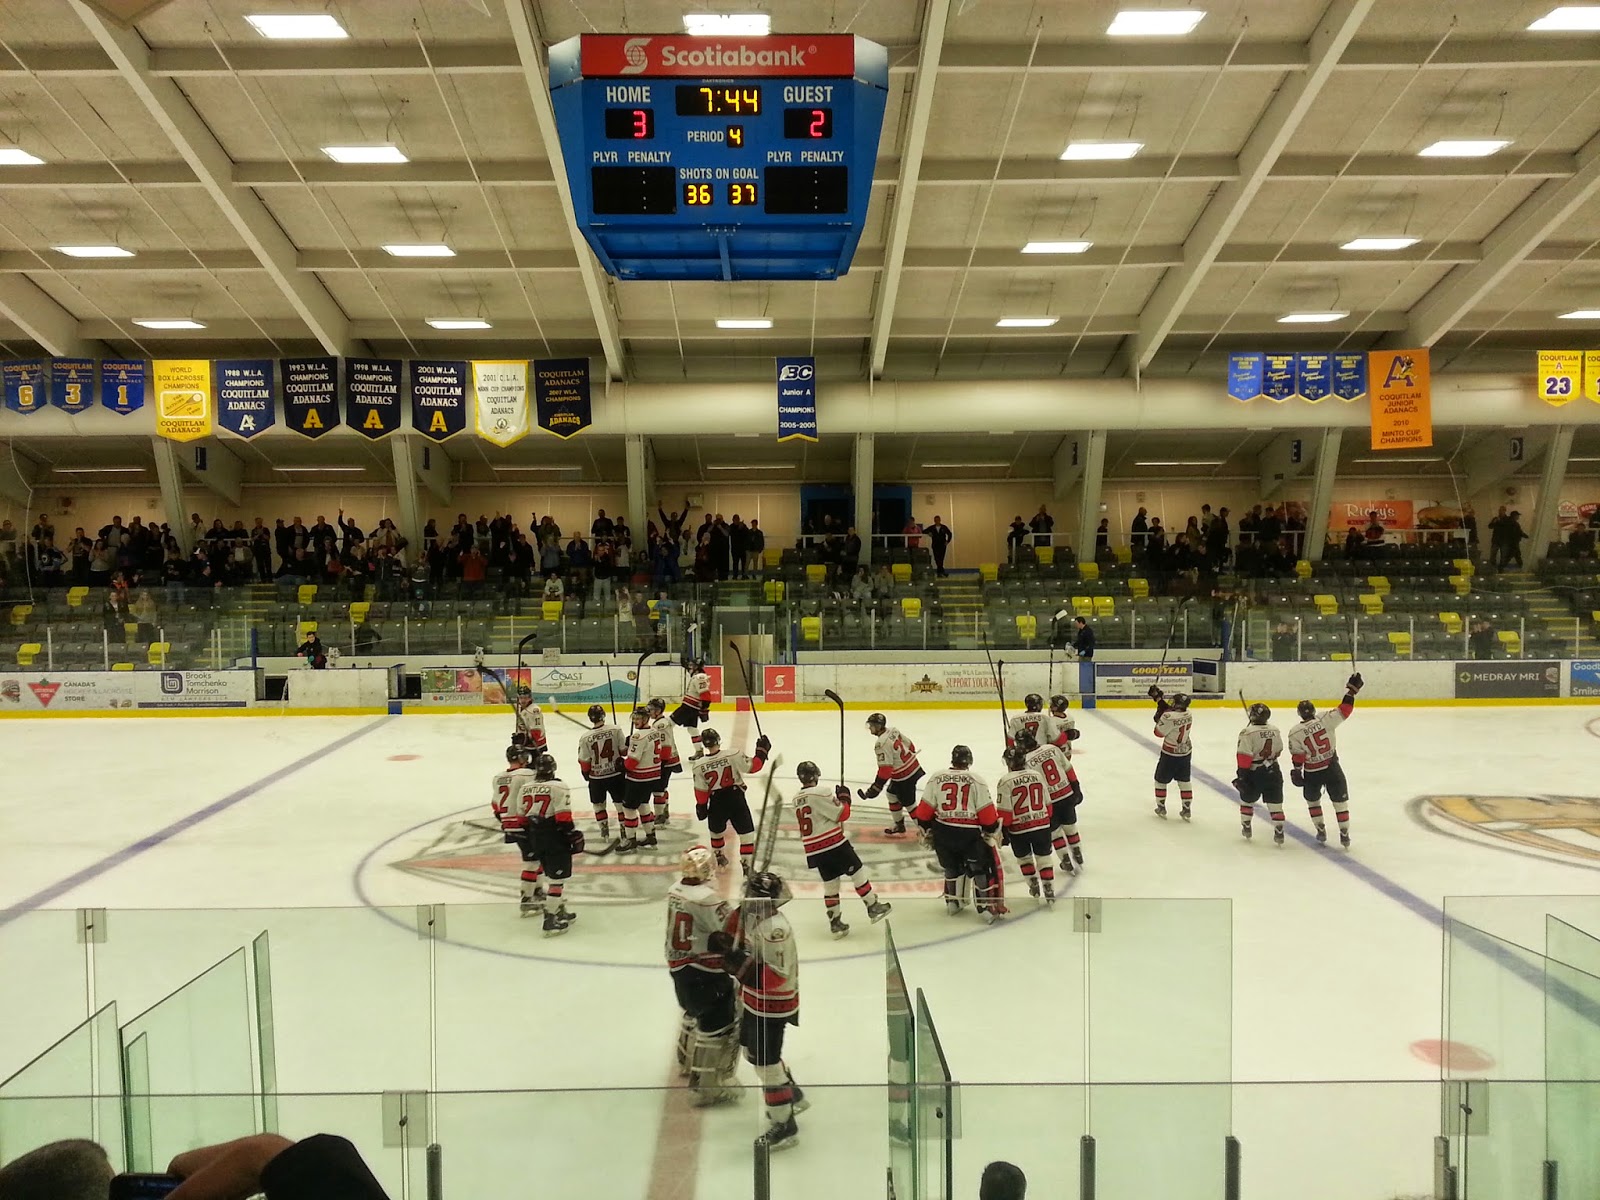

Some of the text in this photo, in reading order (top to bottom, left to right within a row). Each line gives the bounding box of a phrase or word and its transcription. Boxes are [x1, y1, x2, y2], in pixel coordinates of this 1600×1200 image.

[661, 44, 806, 67] Scotiabank
[606, 86, 651, 103] HOME
[700, 87, 758, 112] 7:44
[783, 86, 833, 103] GUEST
[633, 110, 646, 137] 3
[810, 110, 825, 137] 2
[687, 130, 724, 142] PERIOD
[729, 128, 741, 145] 4
[593, 151, 671, 163] PLYR PENALTY
[767, 150, 844, 162] PLYR PENALTY
[680, 168, 759, 180] SHOTS ON GOAL
[687, 184, 711, 203] 36
[732, 184, 755, 203] 37
[53, 362, 93, 370] COQUITLAM
[354, 363, 369, 371] 1998
[417, 366, 435, 374] 2001
[225, 369, 240, 377] 1988
[290, 373, 329, 381] CHAMPIONS
[354, 373, 393, 382] CHAMPIONS
[483, 374, 497, 382] 2001
[538, 370, 585, 379] COQUITLAM
[779, 365, 813, 381] BC
[419, 376, 457, 384] CHAMPIONS
[544, 378, 581, 387] ADANACS
[286, 383, 334, 393] COQUITLAM
[350, 383, 397, 394] COQUITLAM
[414, 386, 462, 396] COQUITLAM
[1546, 377, 1571, 395] 23
[18, 384, 34, 406] 6
[65, 383, 81, 404] 3
[117, 385, 128, 405] 1
[221, 389, 269, 399] COQUITLAM
[293, 394, 331, 404] ADANACS
[545, 395, 582, 403] CHAMPIONS
[1379, 392, 1422, 401] COQUITLAM
[355, 395, 393, 405] ADANACS
[420, 397, 458, 407] ADANACS
[486, 395, 518, 404] COQUITLAM
[227, 401, 266, 410] ADANACS
[490, 407, 514, 415] ADANACS
[1383, 406, 1418, 414] ADANACS
[549, 415, 581, 427] ADANACS
[1380, 436, 1423, 444] CHAMPIONS
[1510, 439, 1520, 459] D
[185, 672, 212, 680] Brooks
[551, 672, 584, 681] COAST
[1473, 673, 1540, 681] MEDRAY MRI
[186, 679, 227, 687] Tomchenko
[946, 677, 971, 688] SUPPORT
[972, 677, 989, 688] YOUR
[186, 687, 219, 695] Morrison
[1020, 715, 1042, 723] MARKS
[1259, 731, 1276, 739] BEGA
[1303, 723, 1322, 736] BOYD
[631, 744, 638, 753] 5
[1258, 738, 1273, 759] 4
[1303, 728, 1331, 758] 15
[591, 738, 615, 764] 14
[1029, 750, 1057, 767] CRESSEY
[700, 758, 730, 773] B.PIEPER
[704, 765, 735, 790] 24
[1041, 758, 1061, 787] 8
[1013, 775, 1039, 787] MACKIN
[499, 785, 510, 813] 2
[941, 782, 971, 811] 31
[1011, 782, 1044, 815] 20
[522, 794, 552, 818] 27
